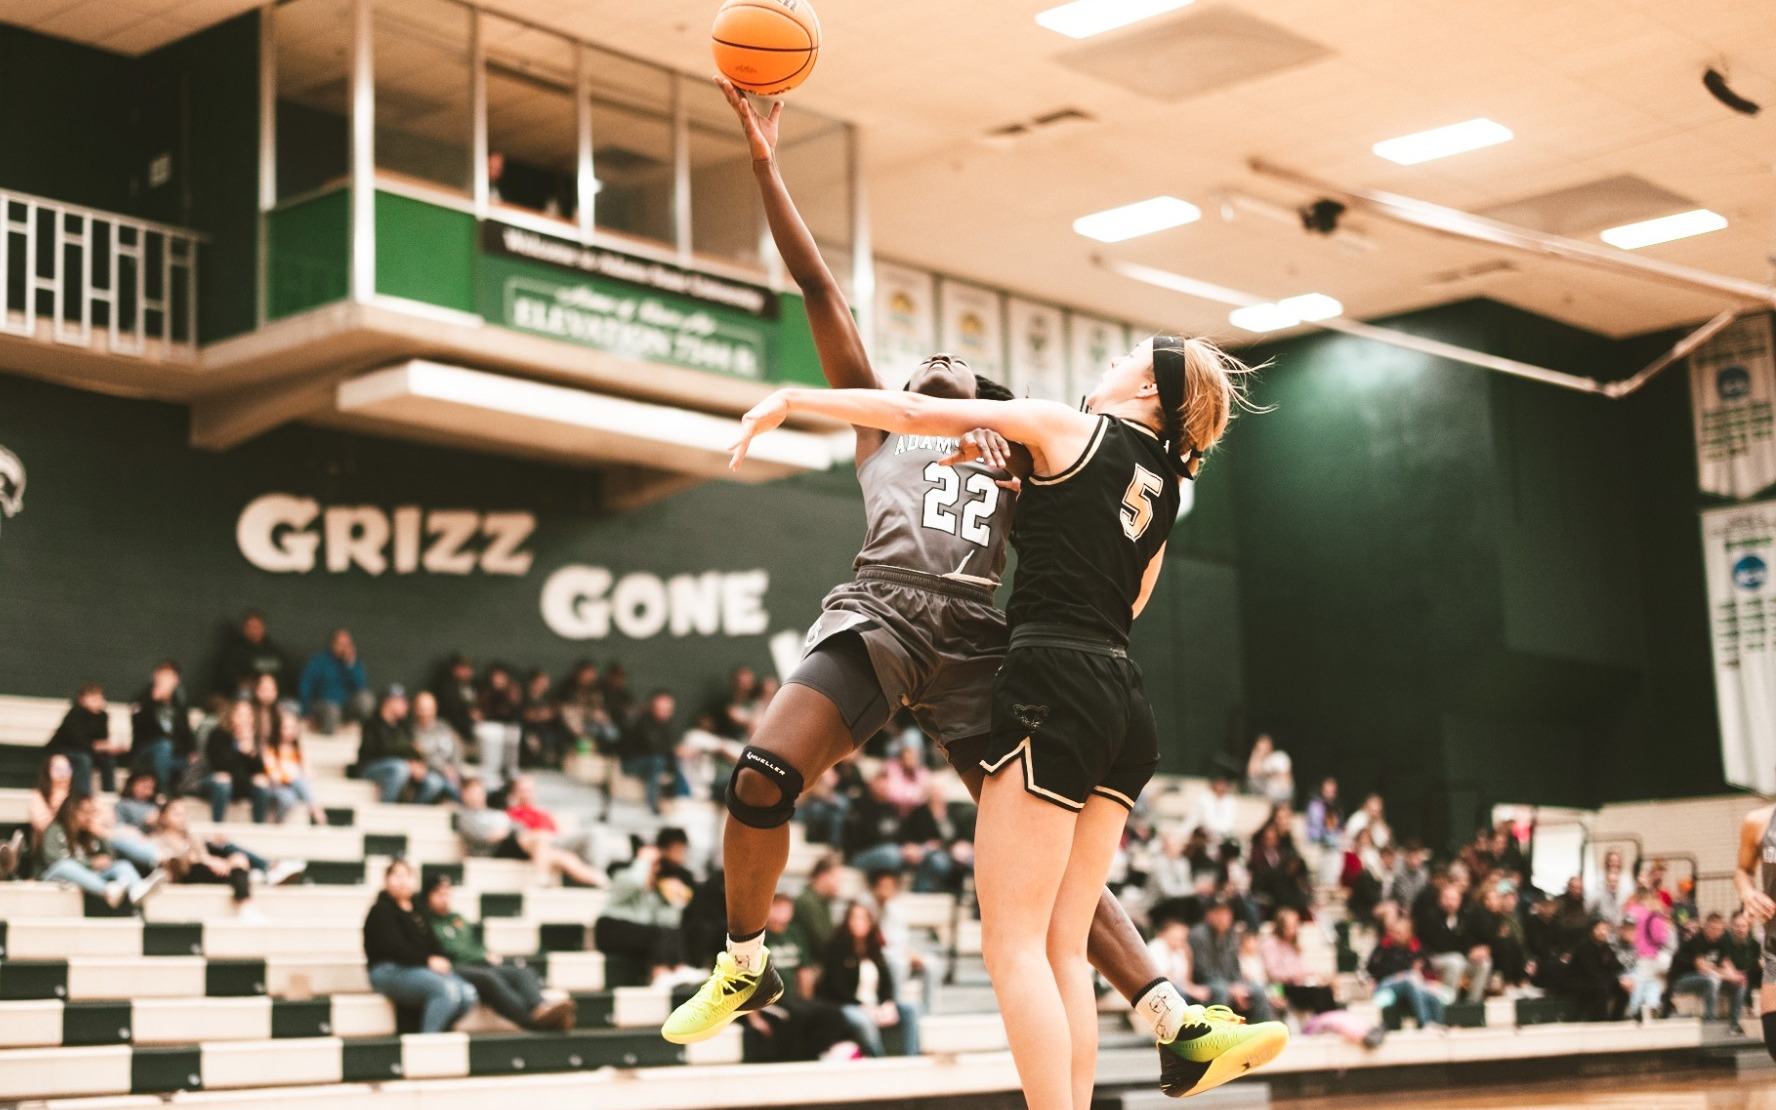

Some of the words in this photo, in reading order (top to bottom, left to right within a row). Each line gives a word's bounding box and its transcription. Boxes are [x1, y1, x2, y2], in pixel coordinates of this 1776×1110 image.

[894, 434, 960, 456] ADAM
[236, 493, 538, 576] GRIZZ
[921, 461, 1001, 548] 22
[1119, 462, 1164, 542] 5
[540, 564, 770, 640] GONE
[748, 752, 786, 776] MUELLER
